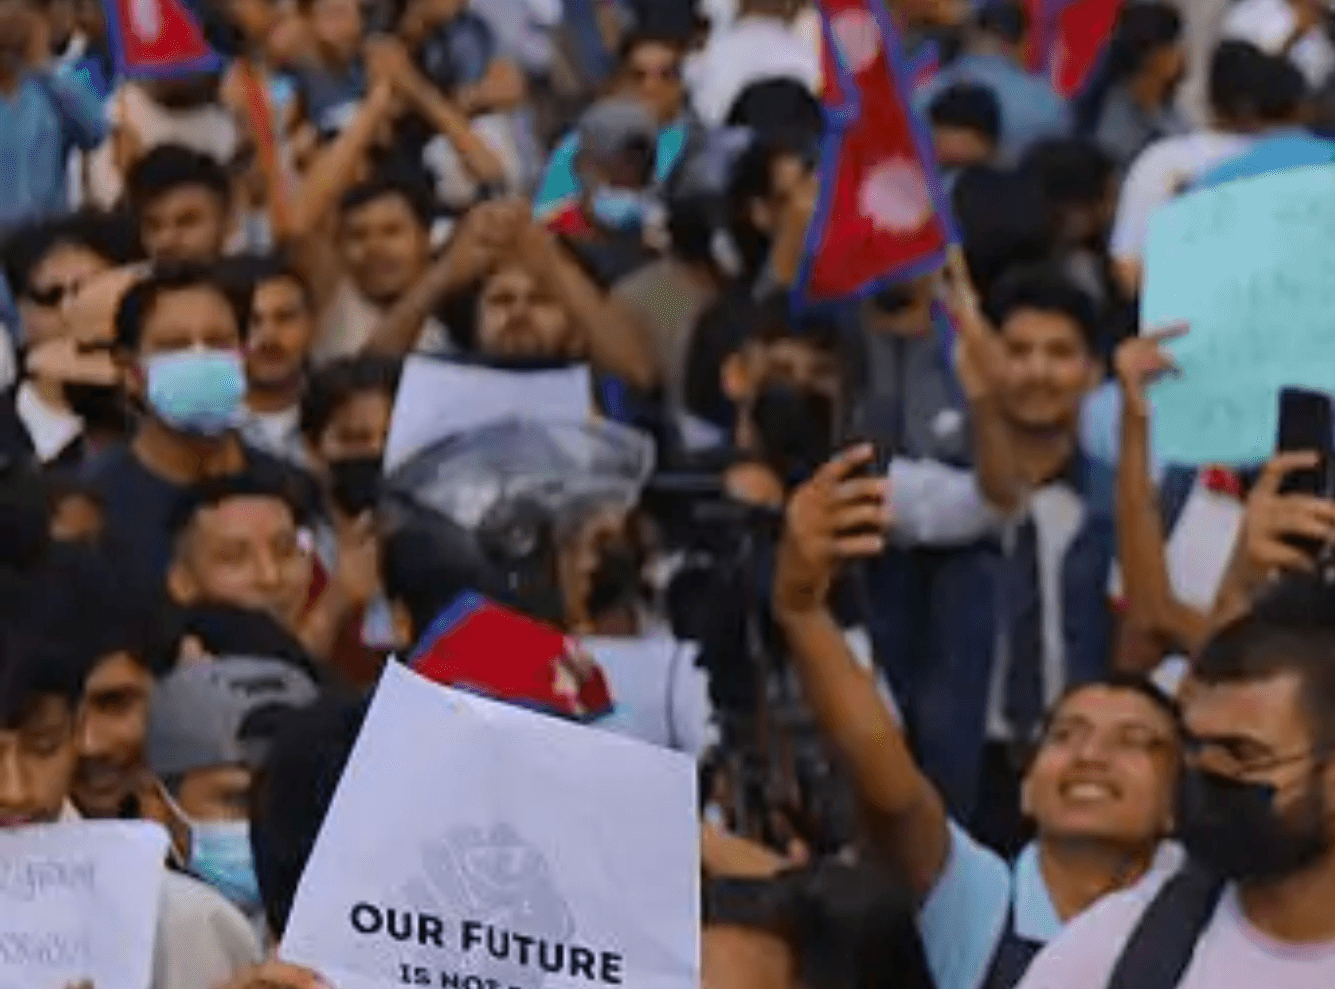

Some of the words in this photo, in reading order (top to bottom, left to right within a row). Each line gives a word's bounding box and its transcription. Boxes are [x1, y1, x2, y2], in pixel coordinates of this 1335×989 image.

[350, 902, 444, 947] OUR
[461, 920, 623, 984] FUTURE
[400, 963, 431, 985] IS
